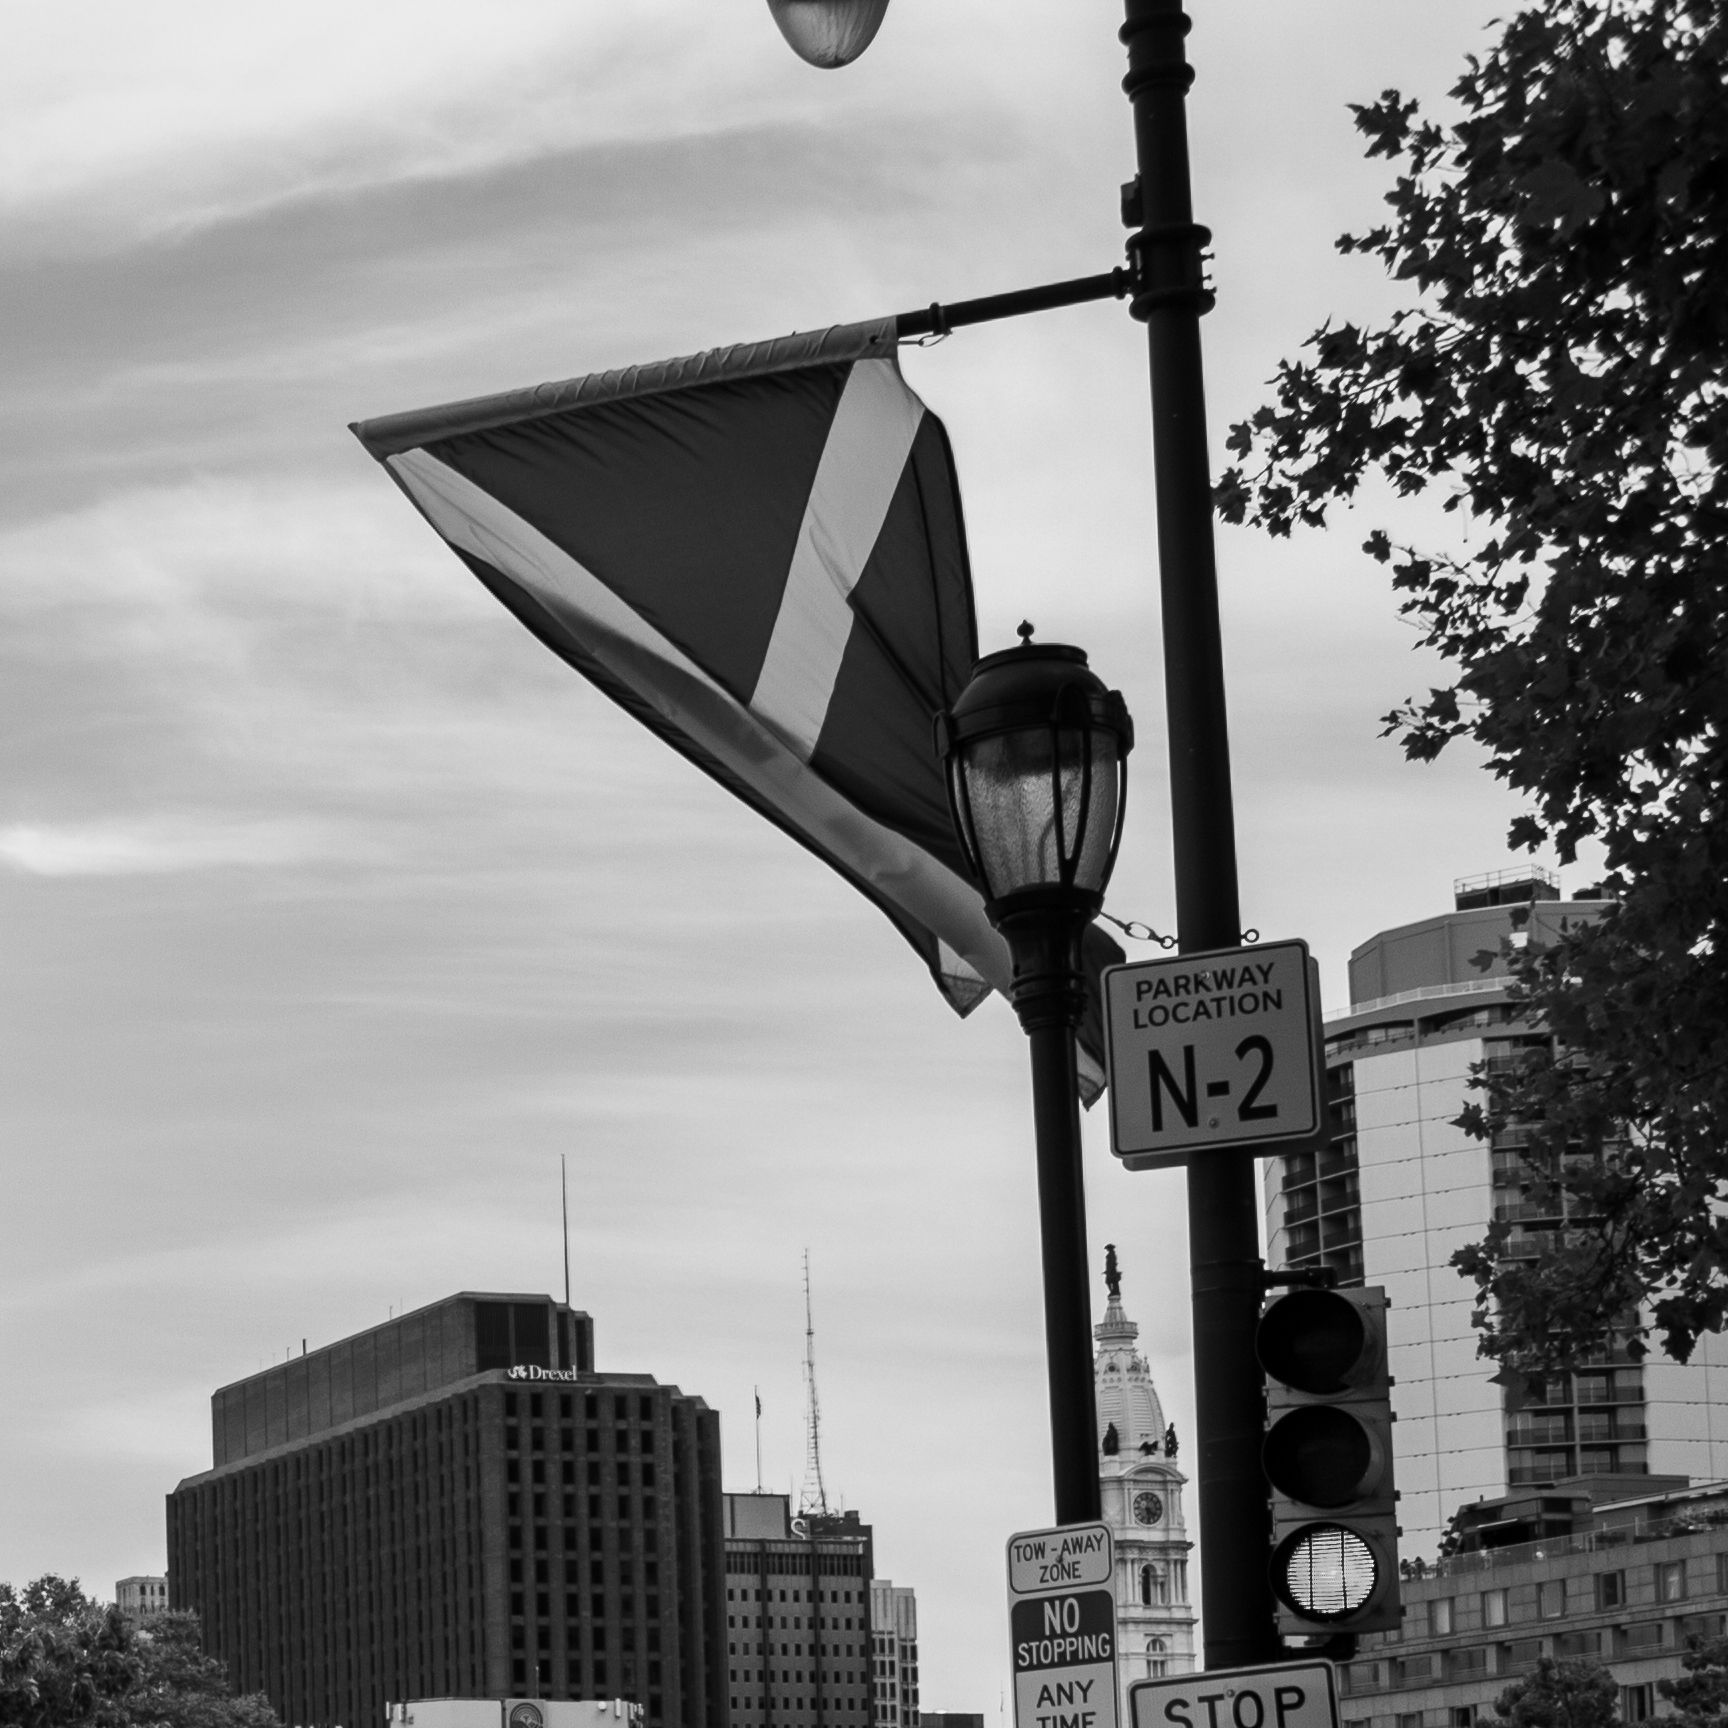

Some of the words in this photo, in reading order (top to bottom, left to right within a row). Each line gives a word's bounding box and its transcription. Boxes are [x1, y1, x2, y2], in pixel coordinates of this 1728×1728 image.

[1135, 961, 1276, 1003] PARKWAY
[1132, 989, 1283, 1029] LOCATION
[1147, 1034, 1279, 1134] N-2
[528, 1364, 577, 1381] Drexel
[1039, 1559, 1083, 1584] ZONE
[1043, 1598, 1081, 1637] NO
[1017, 1632, 1112, 1667] STOPPING
[1035, 1678, 1095, 1710] ANY
